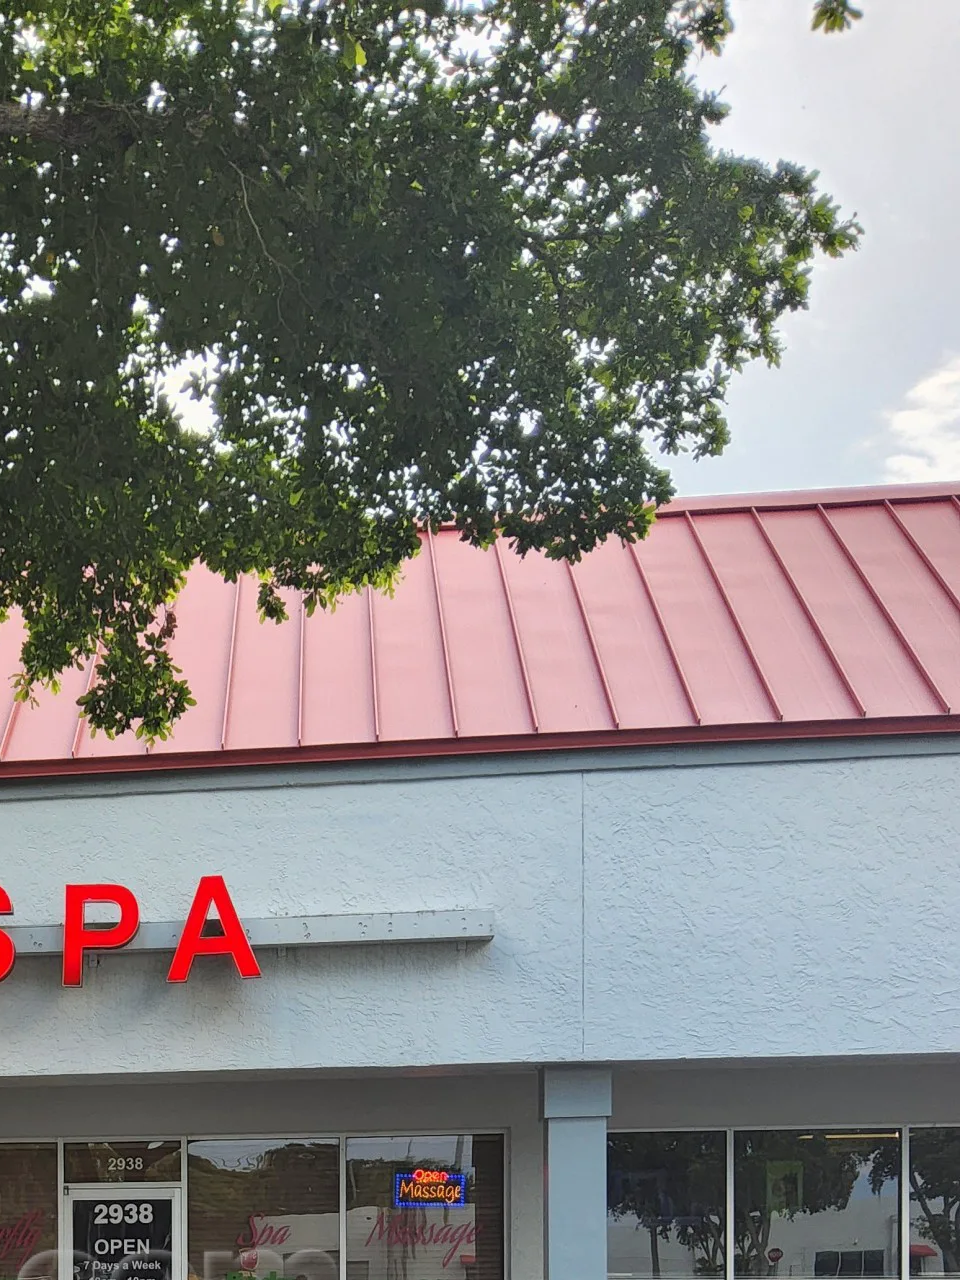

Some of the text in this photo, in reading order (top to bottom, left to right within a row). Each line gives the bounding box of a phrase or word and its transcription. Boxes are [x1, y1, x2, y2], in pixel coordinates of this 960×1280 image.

[108, 1157, 144, 1171] 2938
[413, 1169, 448, 1182] Open
[399, 1180, 462, 1204] Massage
[93, 1203, 154, 1225] 2938
[94, 1238, 151, 1255] OPEN
[236, 1212, 292, 1250] Spa
[364, 1211, 484, 1269] Massage
[83, 1261, 90, 1270] 7
[93, 1261, 120, 1273] Days
[131, 1260, 161, 1270] Week
